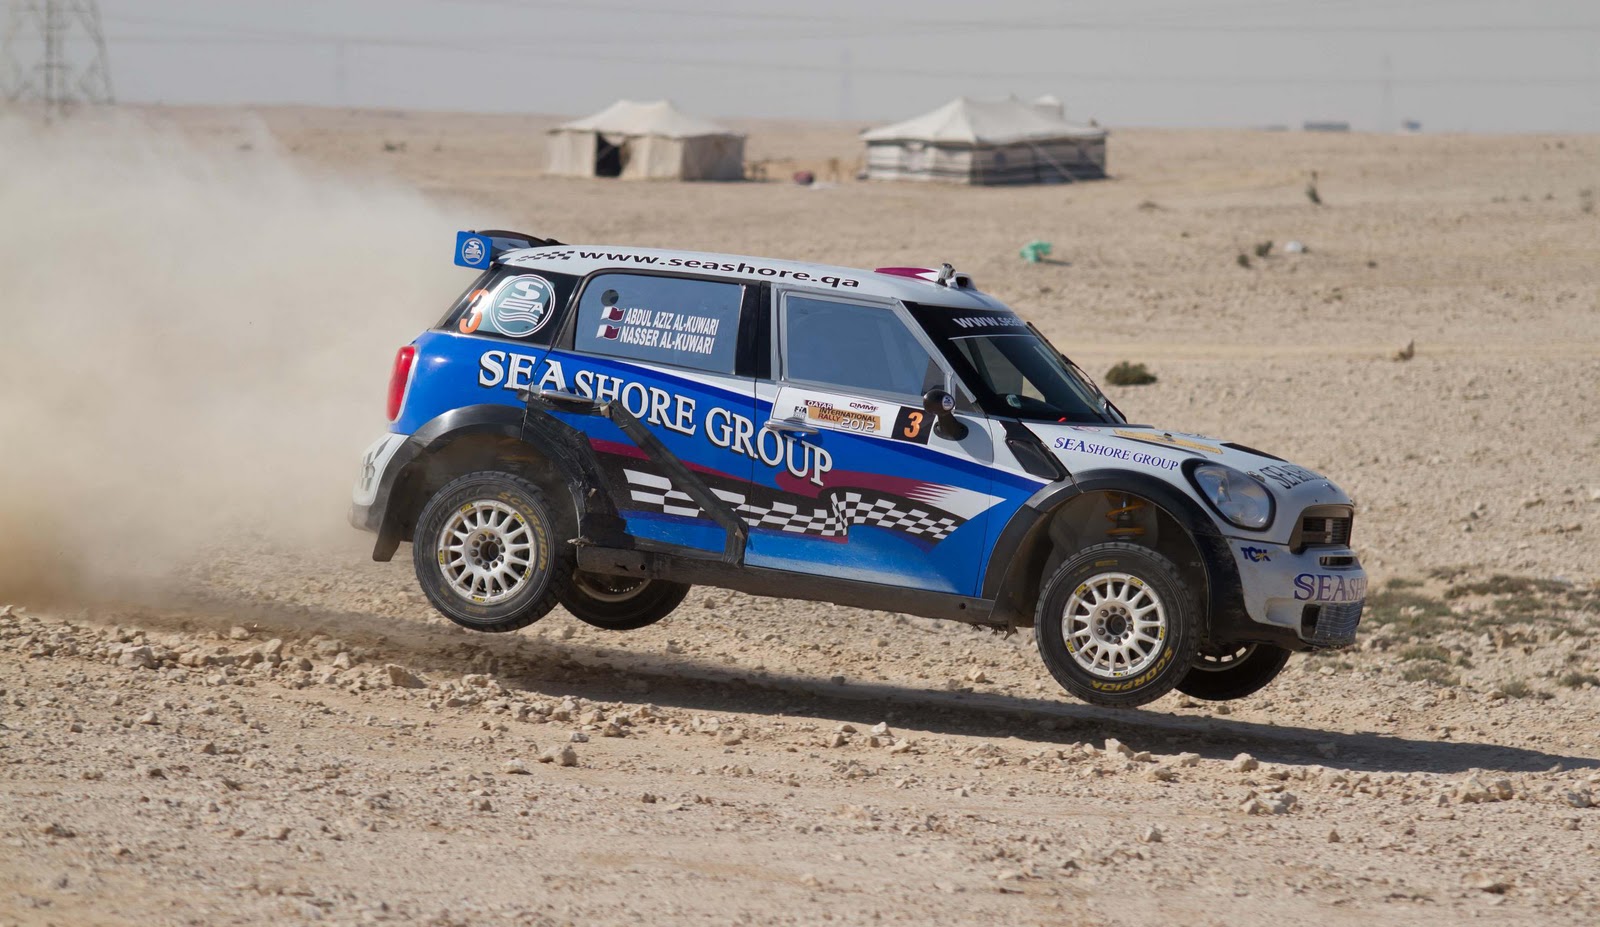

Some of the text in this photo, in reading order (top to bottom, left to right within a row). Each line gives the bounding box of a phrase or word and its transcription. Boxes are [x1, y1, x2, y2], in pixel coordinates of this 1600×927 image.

[579, 251, 859, 289] www.seashore.qa
[458, 288, 490, 334] 3
[624, 307, 720, 336] ABDUL AZIZ AL-KUWARI
[620, 325, 716, 355] NASSER AL-KUWARI
[477, 350, 834, 487] SEASHORE GROUP
[807, 400, 833, 409] QATAR
[818, 414, 840, 422] RALLY
[820, 408, 876, 422] INTERNATIONAL
[841, 419, 875, 433] 2012
[903, 411, 923, 438] 3
[1054, 436, 1131, 460] SEASHORE
[1132, 452, 1179, 471] GROUP
